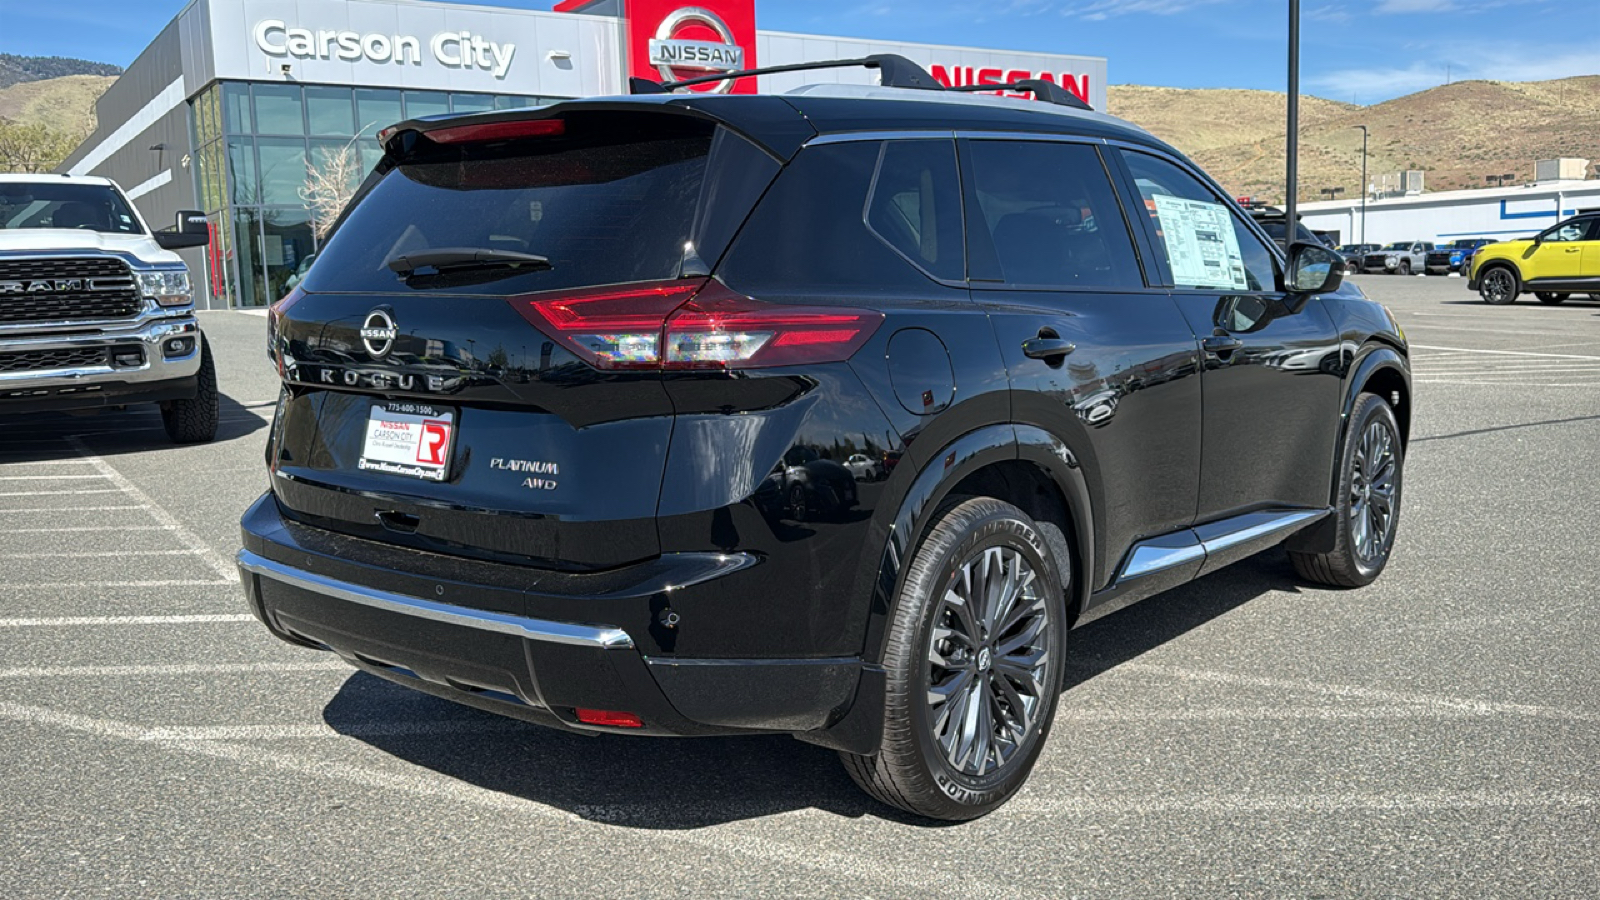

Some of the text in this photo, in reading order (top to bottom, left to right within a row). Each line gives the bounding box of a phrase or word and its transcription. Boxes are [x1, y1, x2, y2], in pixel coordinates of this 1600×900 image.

[254, 19, 516, 79] Carson City
[660, 45, 737, 64] NISSAN
[0, 279, 82, 292] RAM
[360, 328, 396, 340] NISSAN
[320, 368, 444, 391] ROGUE
[388, 404, 433, 415] 775-600-1500
[380, 421, 410, 430] NISSAN
[373, 429, 414, 441] CARSON CITY
[490, 457, 559, 475] PLATINUM
[521, 477, 557, 490] AWD
